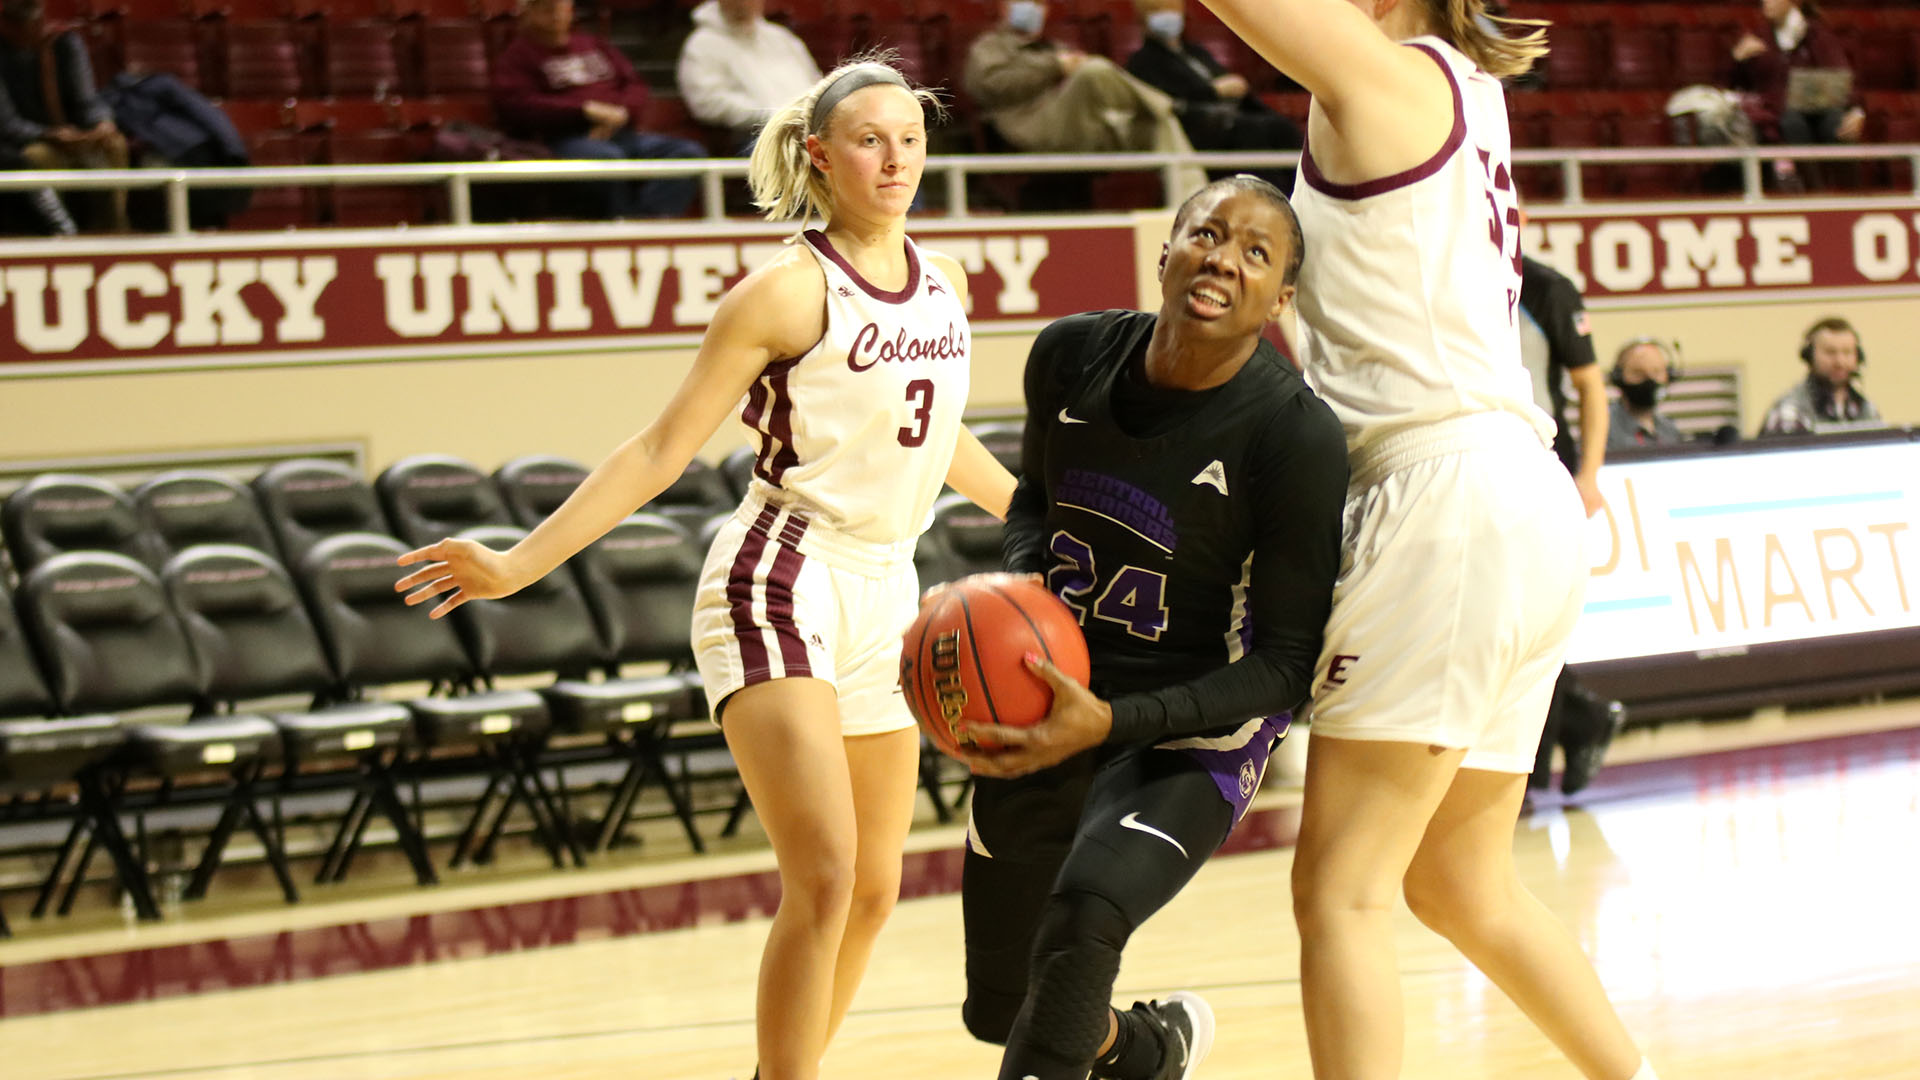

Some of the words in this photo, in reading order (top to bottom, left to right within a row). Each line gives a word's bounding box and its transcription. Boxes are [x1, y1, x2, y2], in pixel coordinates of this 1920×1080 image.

[1851, 212, 1920, 281] O
[0, 255, 337, 353] UCKY
[847, 321, 965, 373] Colonels
[897, 378, 935, 448] 3
[1047, 529, 1169, 642] 24
